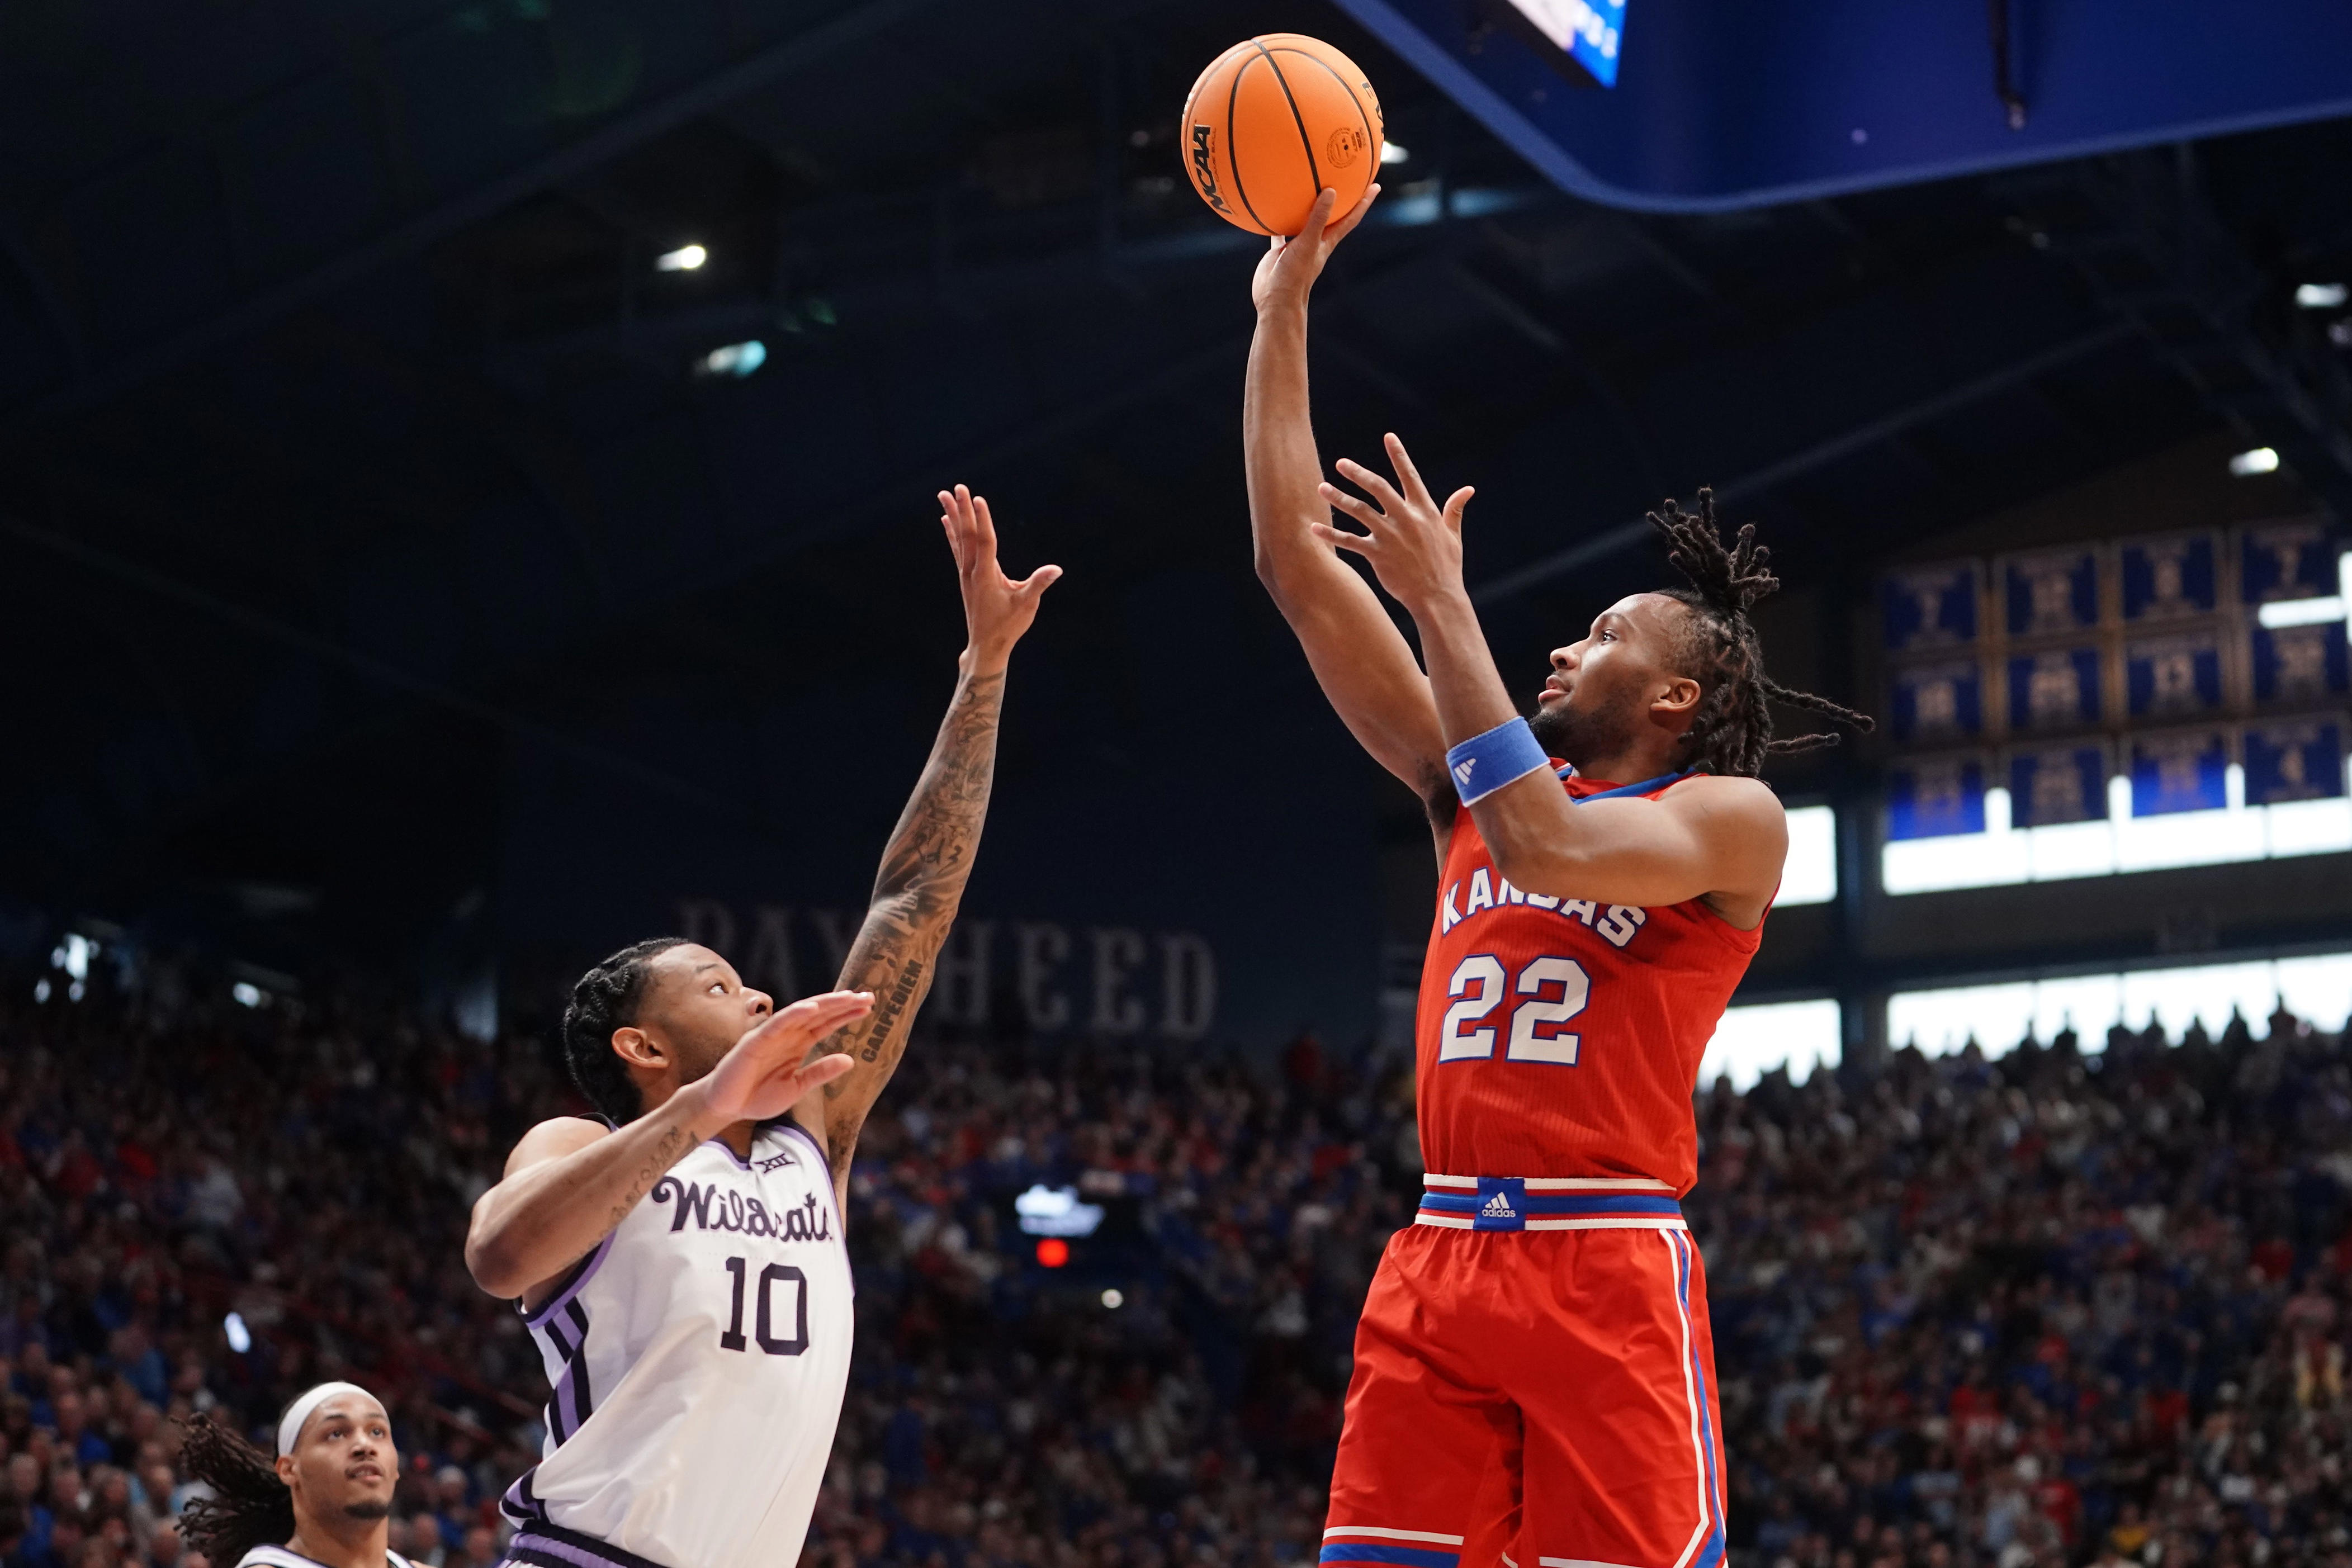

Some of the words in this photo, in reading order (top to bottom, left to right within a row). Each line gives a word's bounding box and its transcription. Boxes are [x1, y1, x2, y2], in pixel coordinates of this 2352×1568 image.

[1193, 124, 1232, 215] NCAA
[935, 920, 1219, 1039] HEED
[1438, 953, 1592, 1068] 22
[1482, 1207, 1516, 1218] adidas
[720, 1256, 810, 1357] 10
